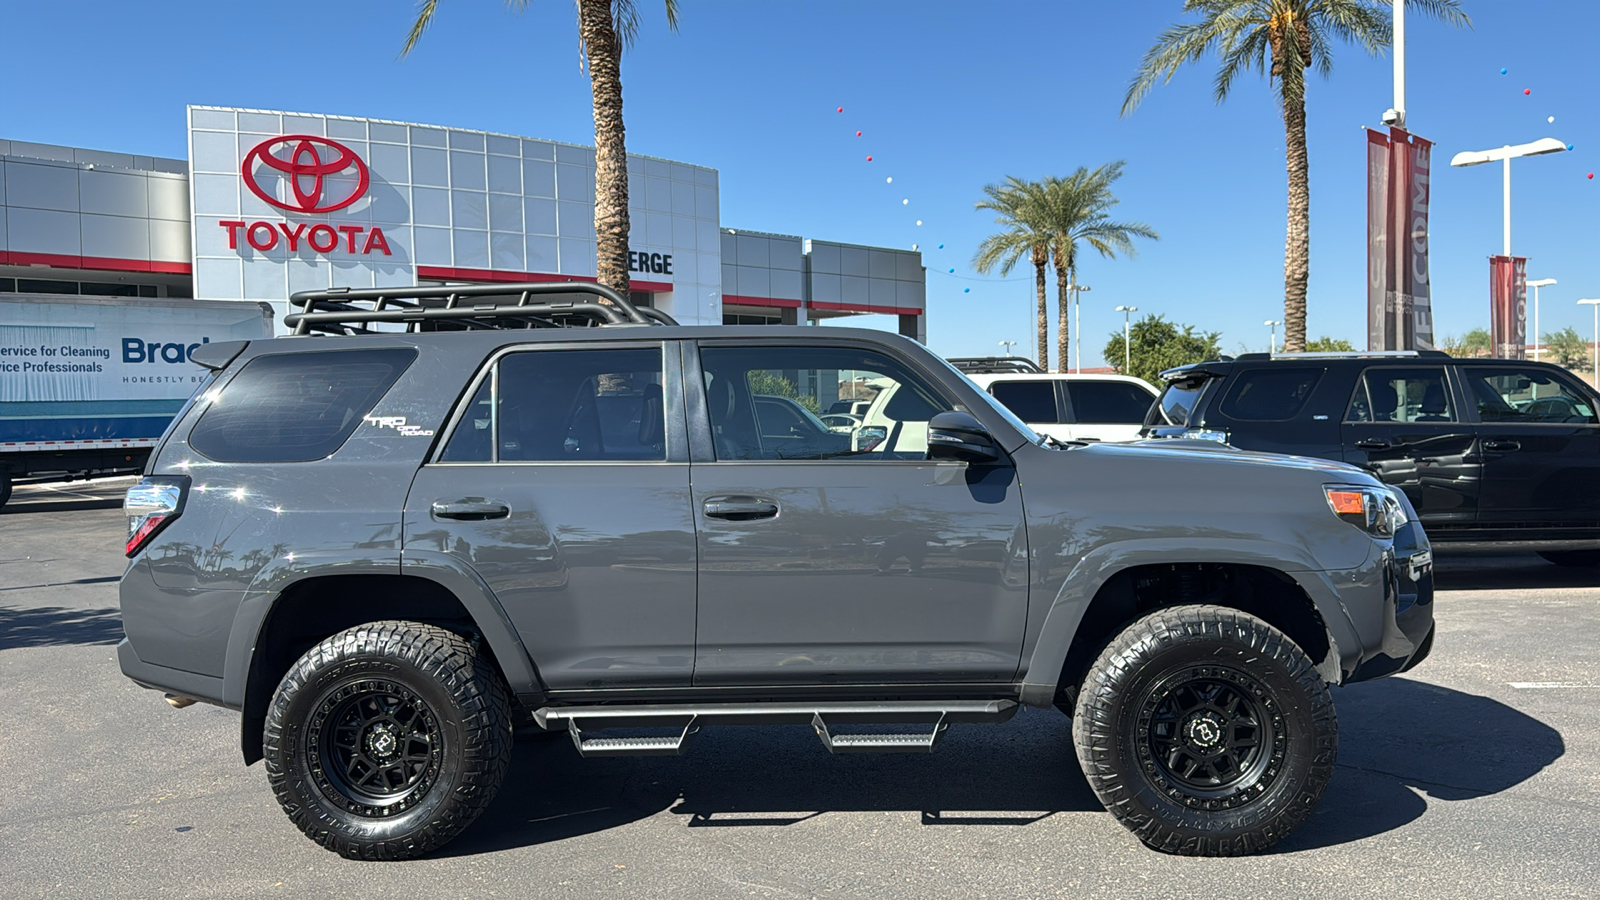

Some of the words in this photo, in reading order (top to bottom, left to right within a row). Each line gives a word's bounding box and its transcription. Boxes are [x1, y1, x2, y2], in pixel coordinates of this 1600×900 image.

[219, 220, 392, 256] TOYOTA
[628, 250, 673, 275] ERGE
[0, 345, 37, 356] ervice
[40, 345, 57, 356] for
[60, 345, 110, 359] Cleaning
[23, 361, 103, 372] Professionals
[366, 416, 407, 429] TRD
